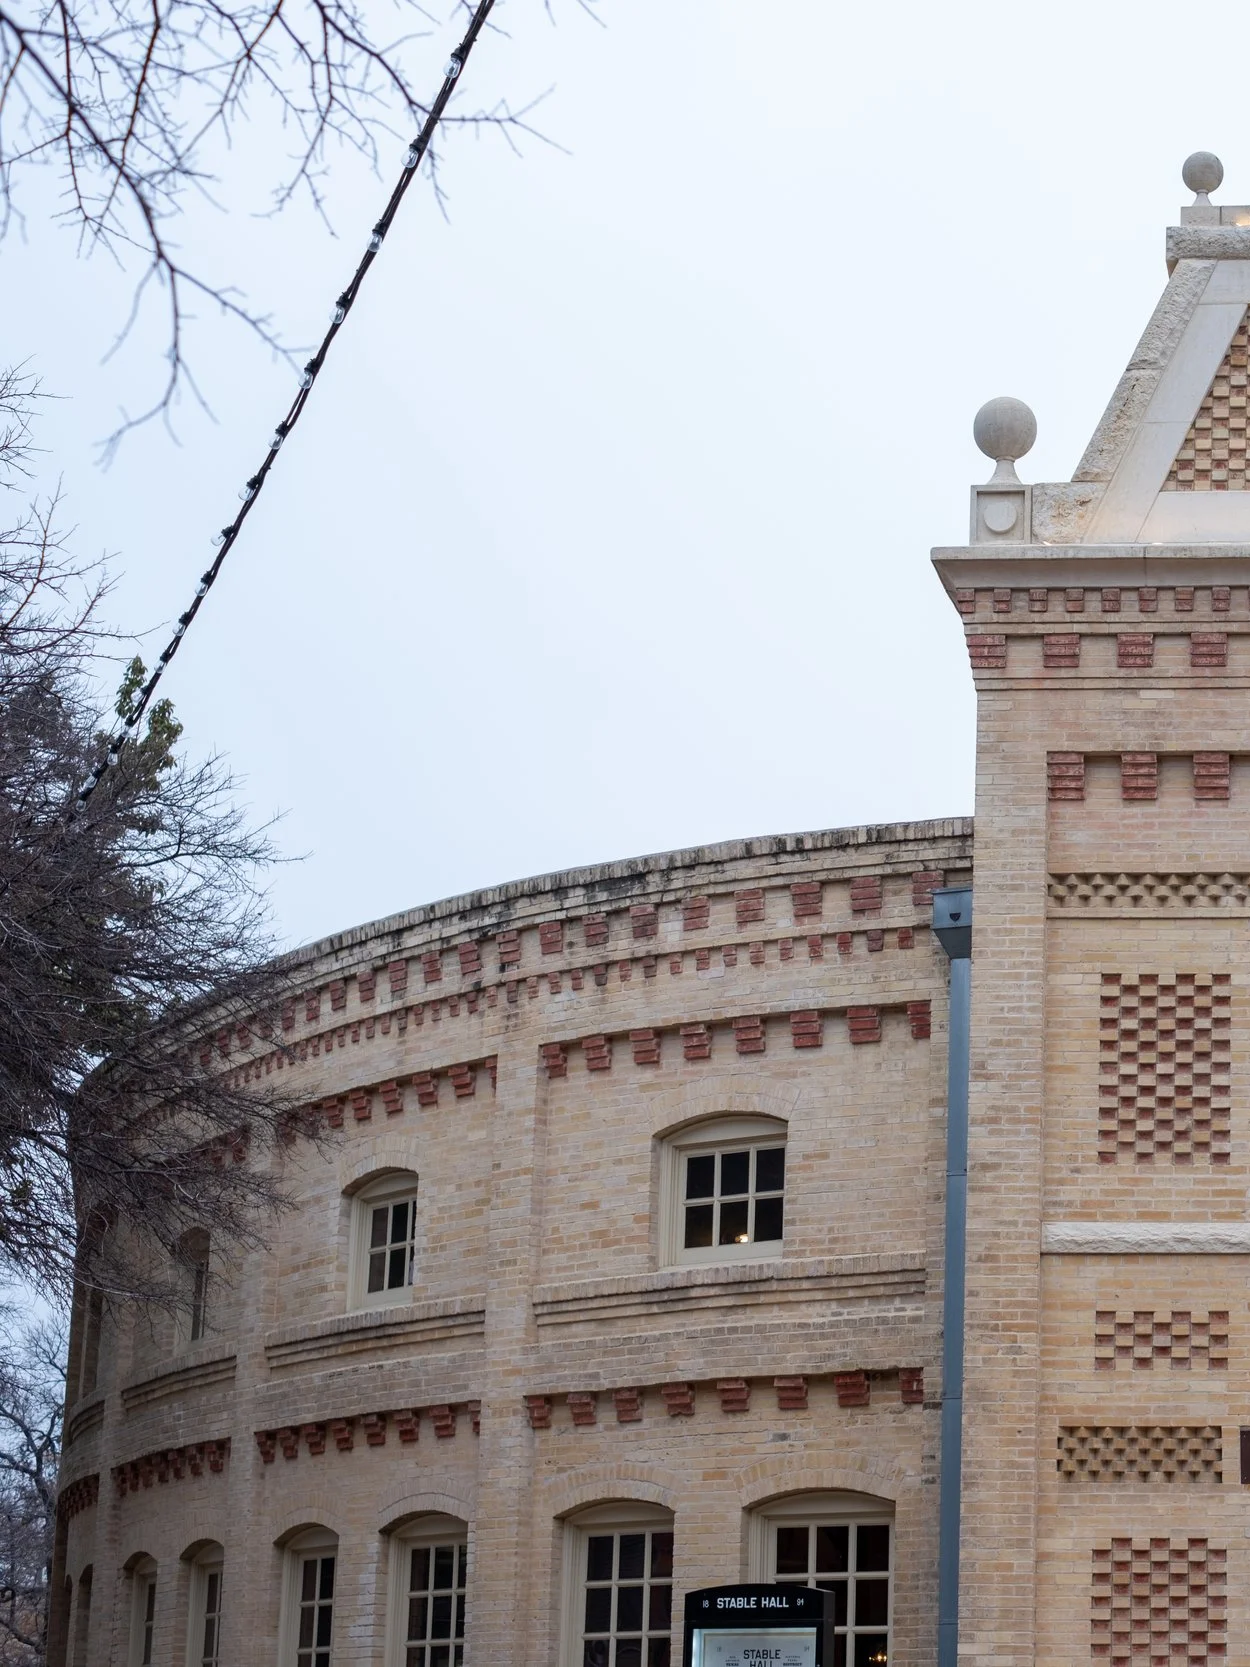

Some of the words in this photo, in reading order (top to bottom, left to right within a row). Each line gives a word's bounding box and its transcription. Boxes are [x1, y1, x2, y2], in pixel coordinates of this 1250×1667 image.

[702, 1600, 710, 1608] 18
[716, 1597, 757, 1609] STABLE
[761, 1597, 789, 1608] HALL
[796, 1598, 804, 1606] 94
[743, 1649, 781, 1660] STABLE
